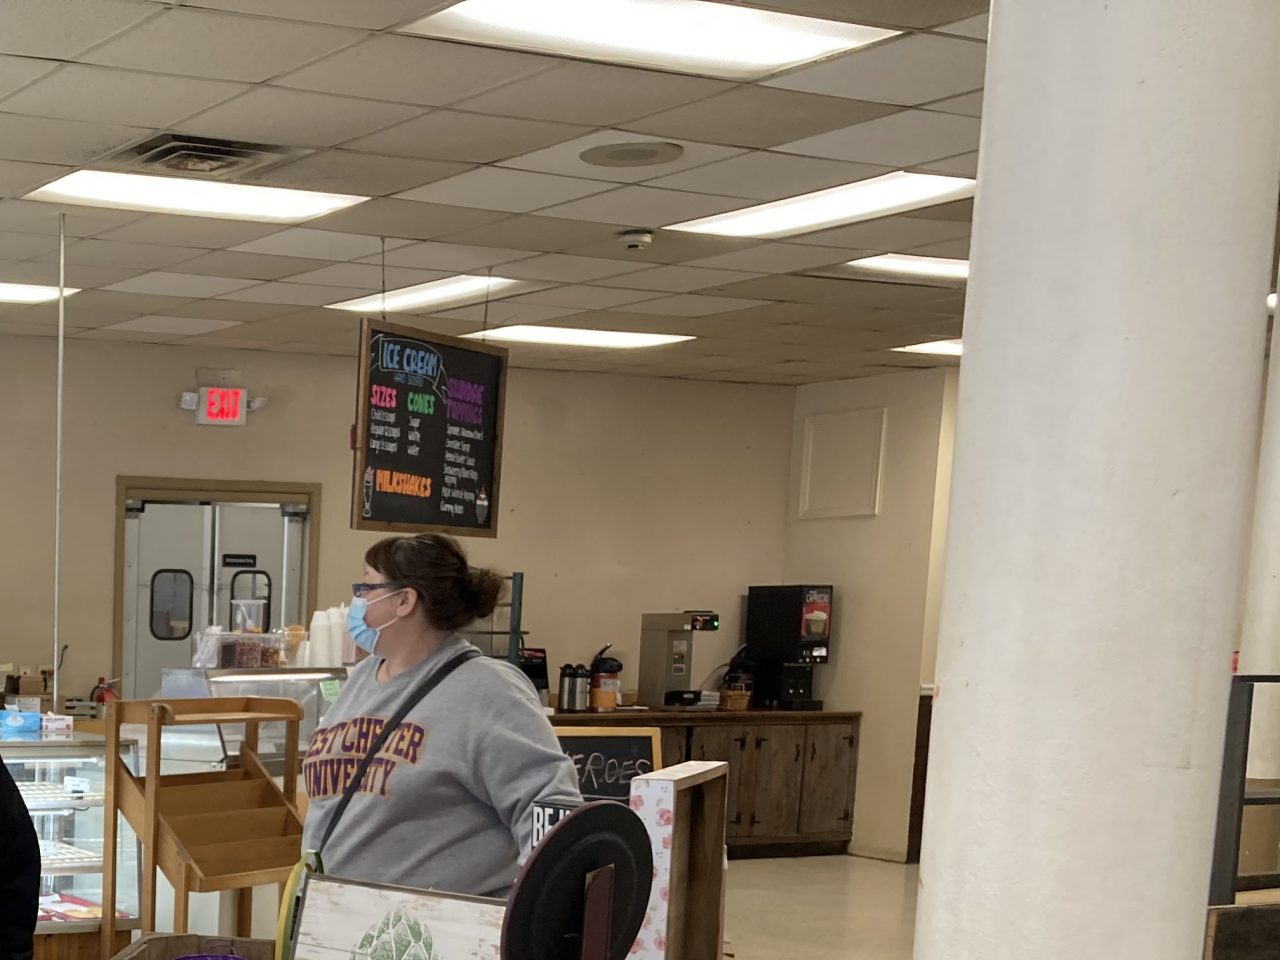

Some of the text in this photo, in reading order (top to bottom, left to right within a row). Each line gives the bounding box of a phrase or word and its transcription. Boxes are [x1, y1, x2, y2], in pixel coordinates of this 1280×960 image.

[382, 342, 438, 377] ICE CREAM
[206, 387, 243, 420] EXIT
[370, 384, 397, 408] SIZES
[407, 391, 435, 415] CONES
[375, 469, 432, 498] MILKSHAKES
[341, 717, 424, 764] CHETER
